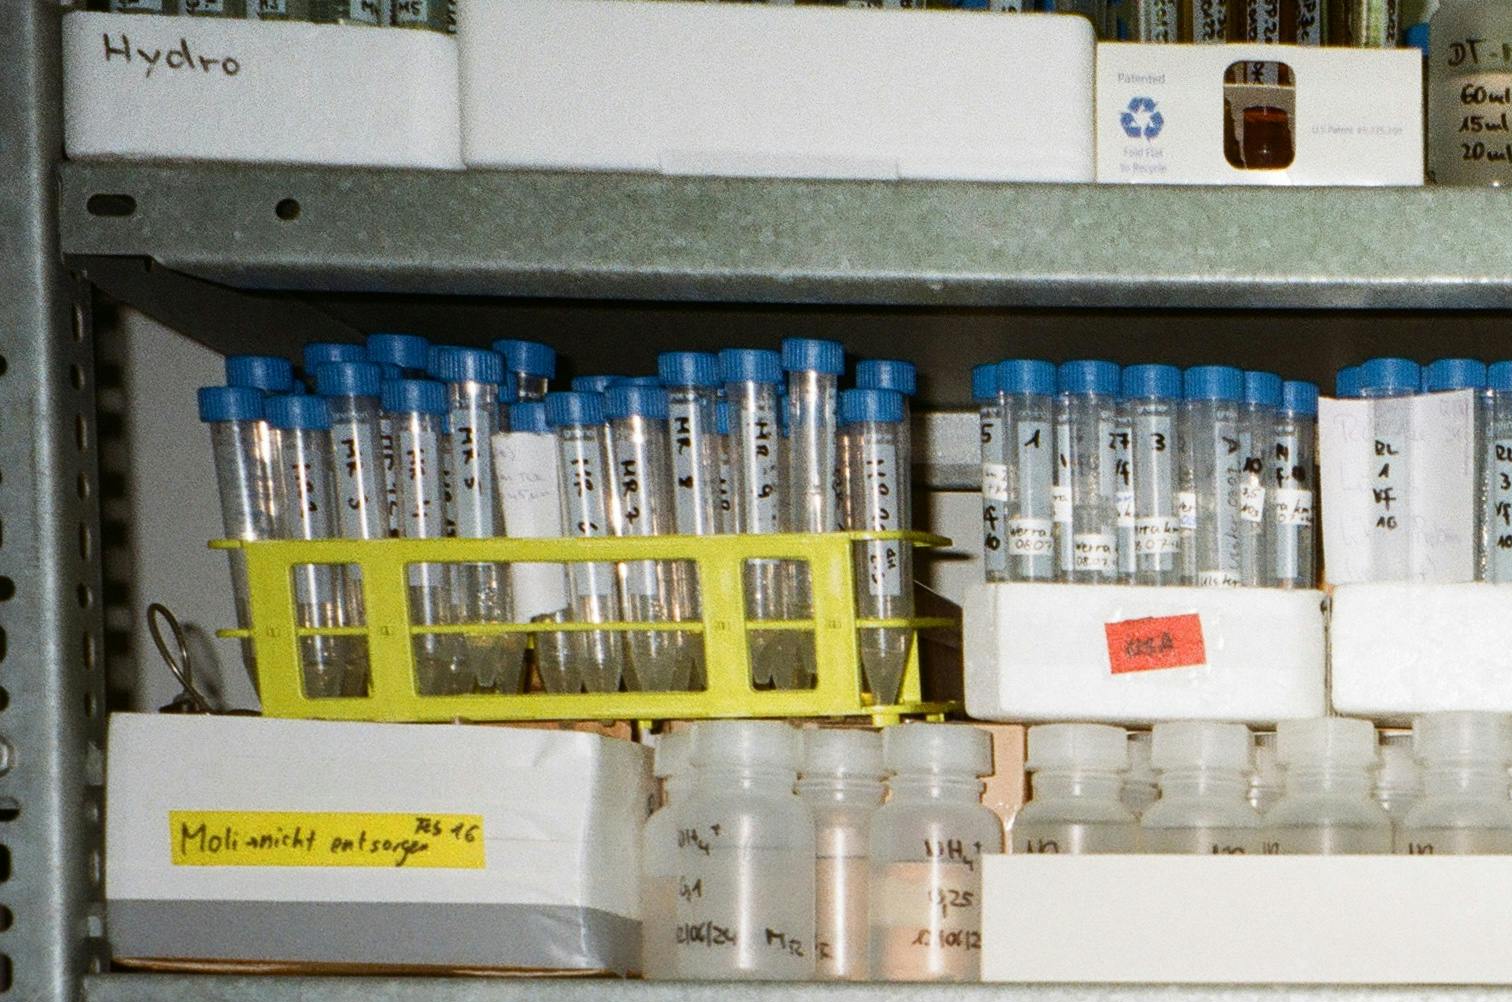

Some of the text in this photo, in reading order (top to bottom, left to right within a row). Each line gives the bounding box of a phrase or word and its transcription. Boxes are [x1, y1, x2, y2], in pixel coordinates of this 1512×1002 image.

[102, 33, 241, 78] Hydro
[1152, 433, 1166, 452] 3
[1500, 472, 1511, 491] 3
[180, 822, 239, 856] Moli
[450, 823, 480, 844] 16
